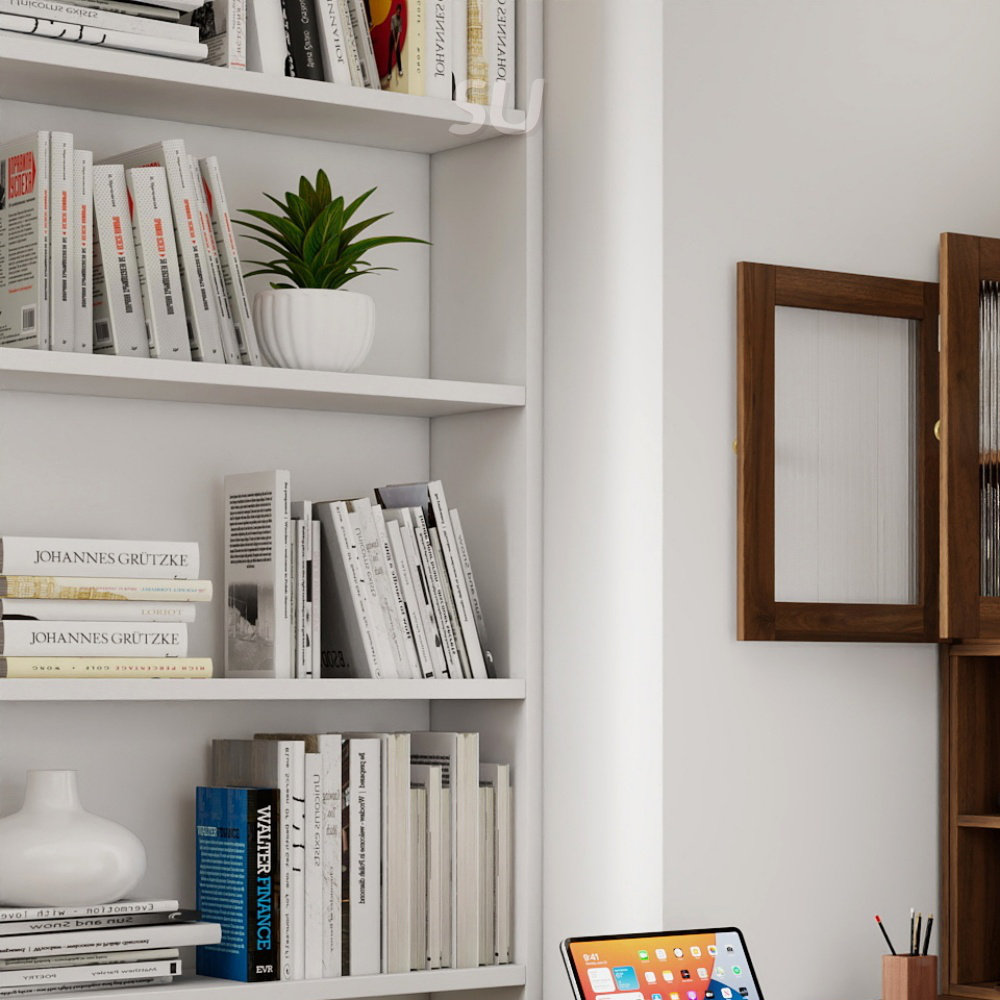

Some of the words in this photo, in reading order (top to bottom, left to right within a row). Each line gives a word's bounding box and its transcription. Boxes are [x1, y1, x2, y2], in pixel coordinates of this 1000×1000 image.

[33, 550, 115, 564] JOHANNES
[117, 551, 188, 566] GRÜTZKE
[29, 632, 108, 644] JOHANNES
[111, 631, 179, 644] GRÜTZKE
[256, 804, 271, 874] WALTER
[256, 876, 271, 950] FINANCE
